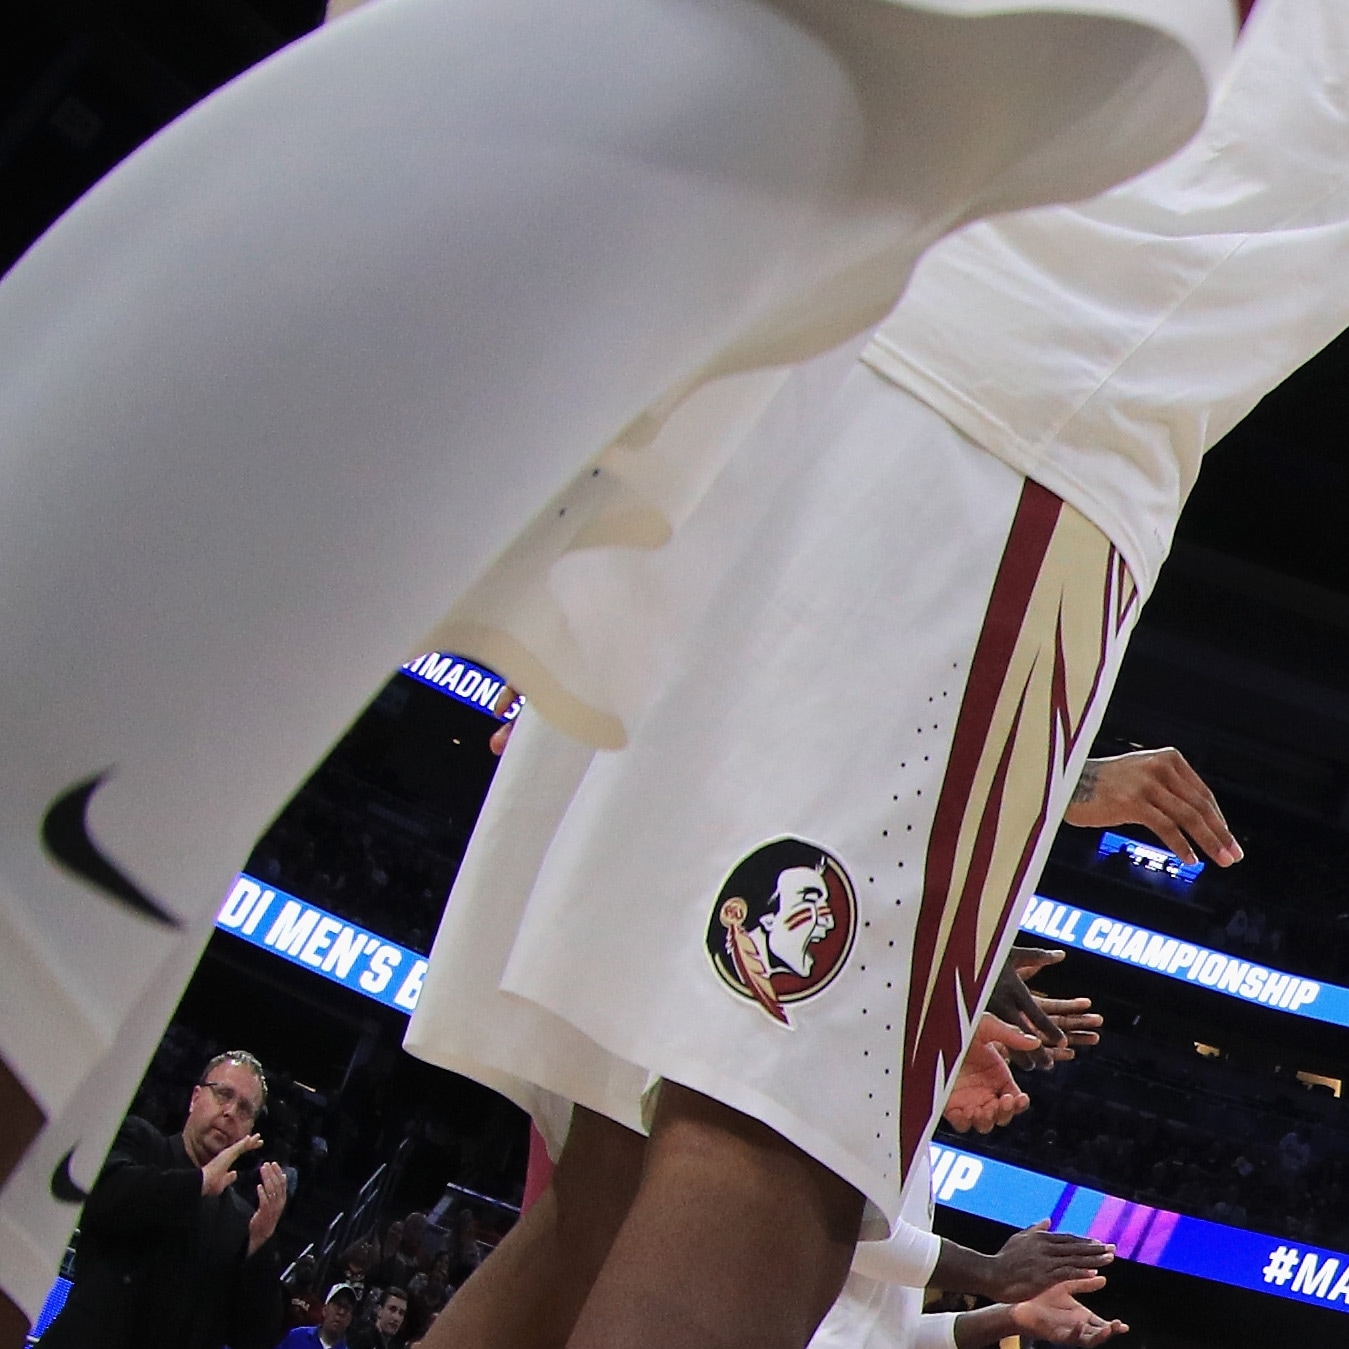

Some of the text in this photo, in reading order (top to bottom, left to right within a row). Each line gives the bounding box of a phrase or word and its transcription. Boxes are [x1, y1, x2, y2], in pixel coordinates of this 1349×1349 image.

[217, 877, 276, 936] DI
[264, 899, 402, 994] MEN'S
[1082, 917, 1320, 1011] CHAMPIONSHIP
